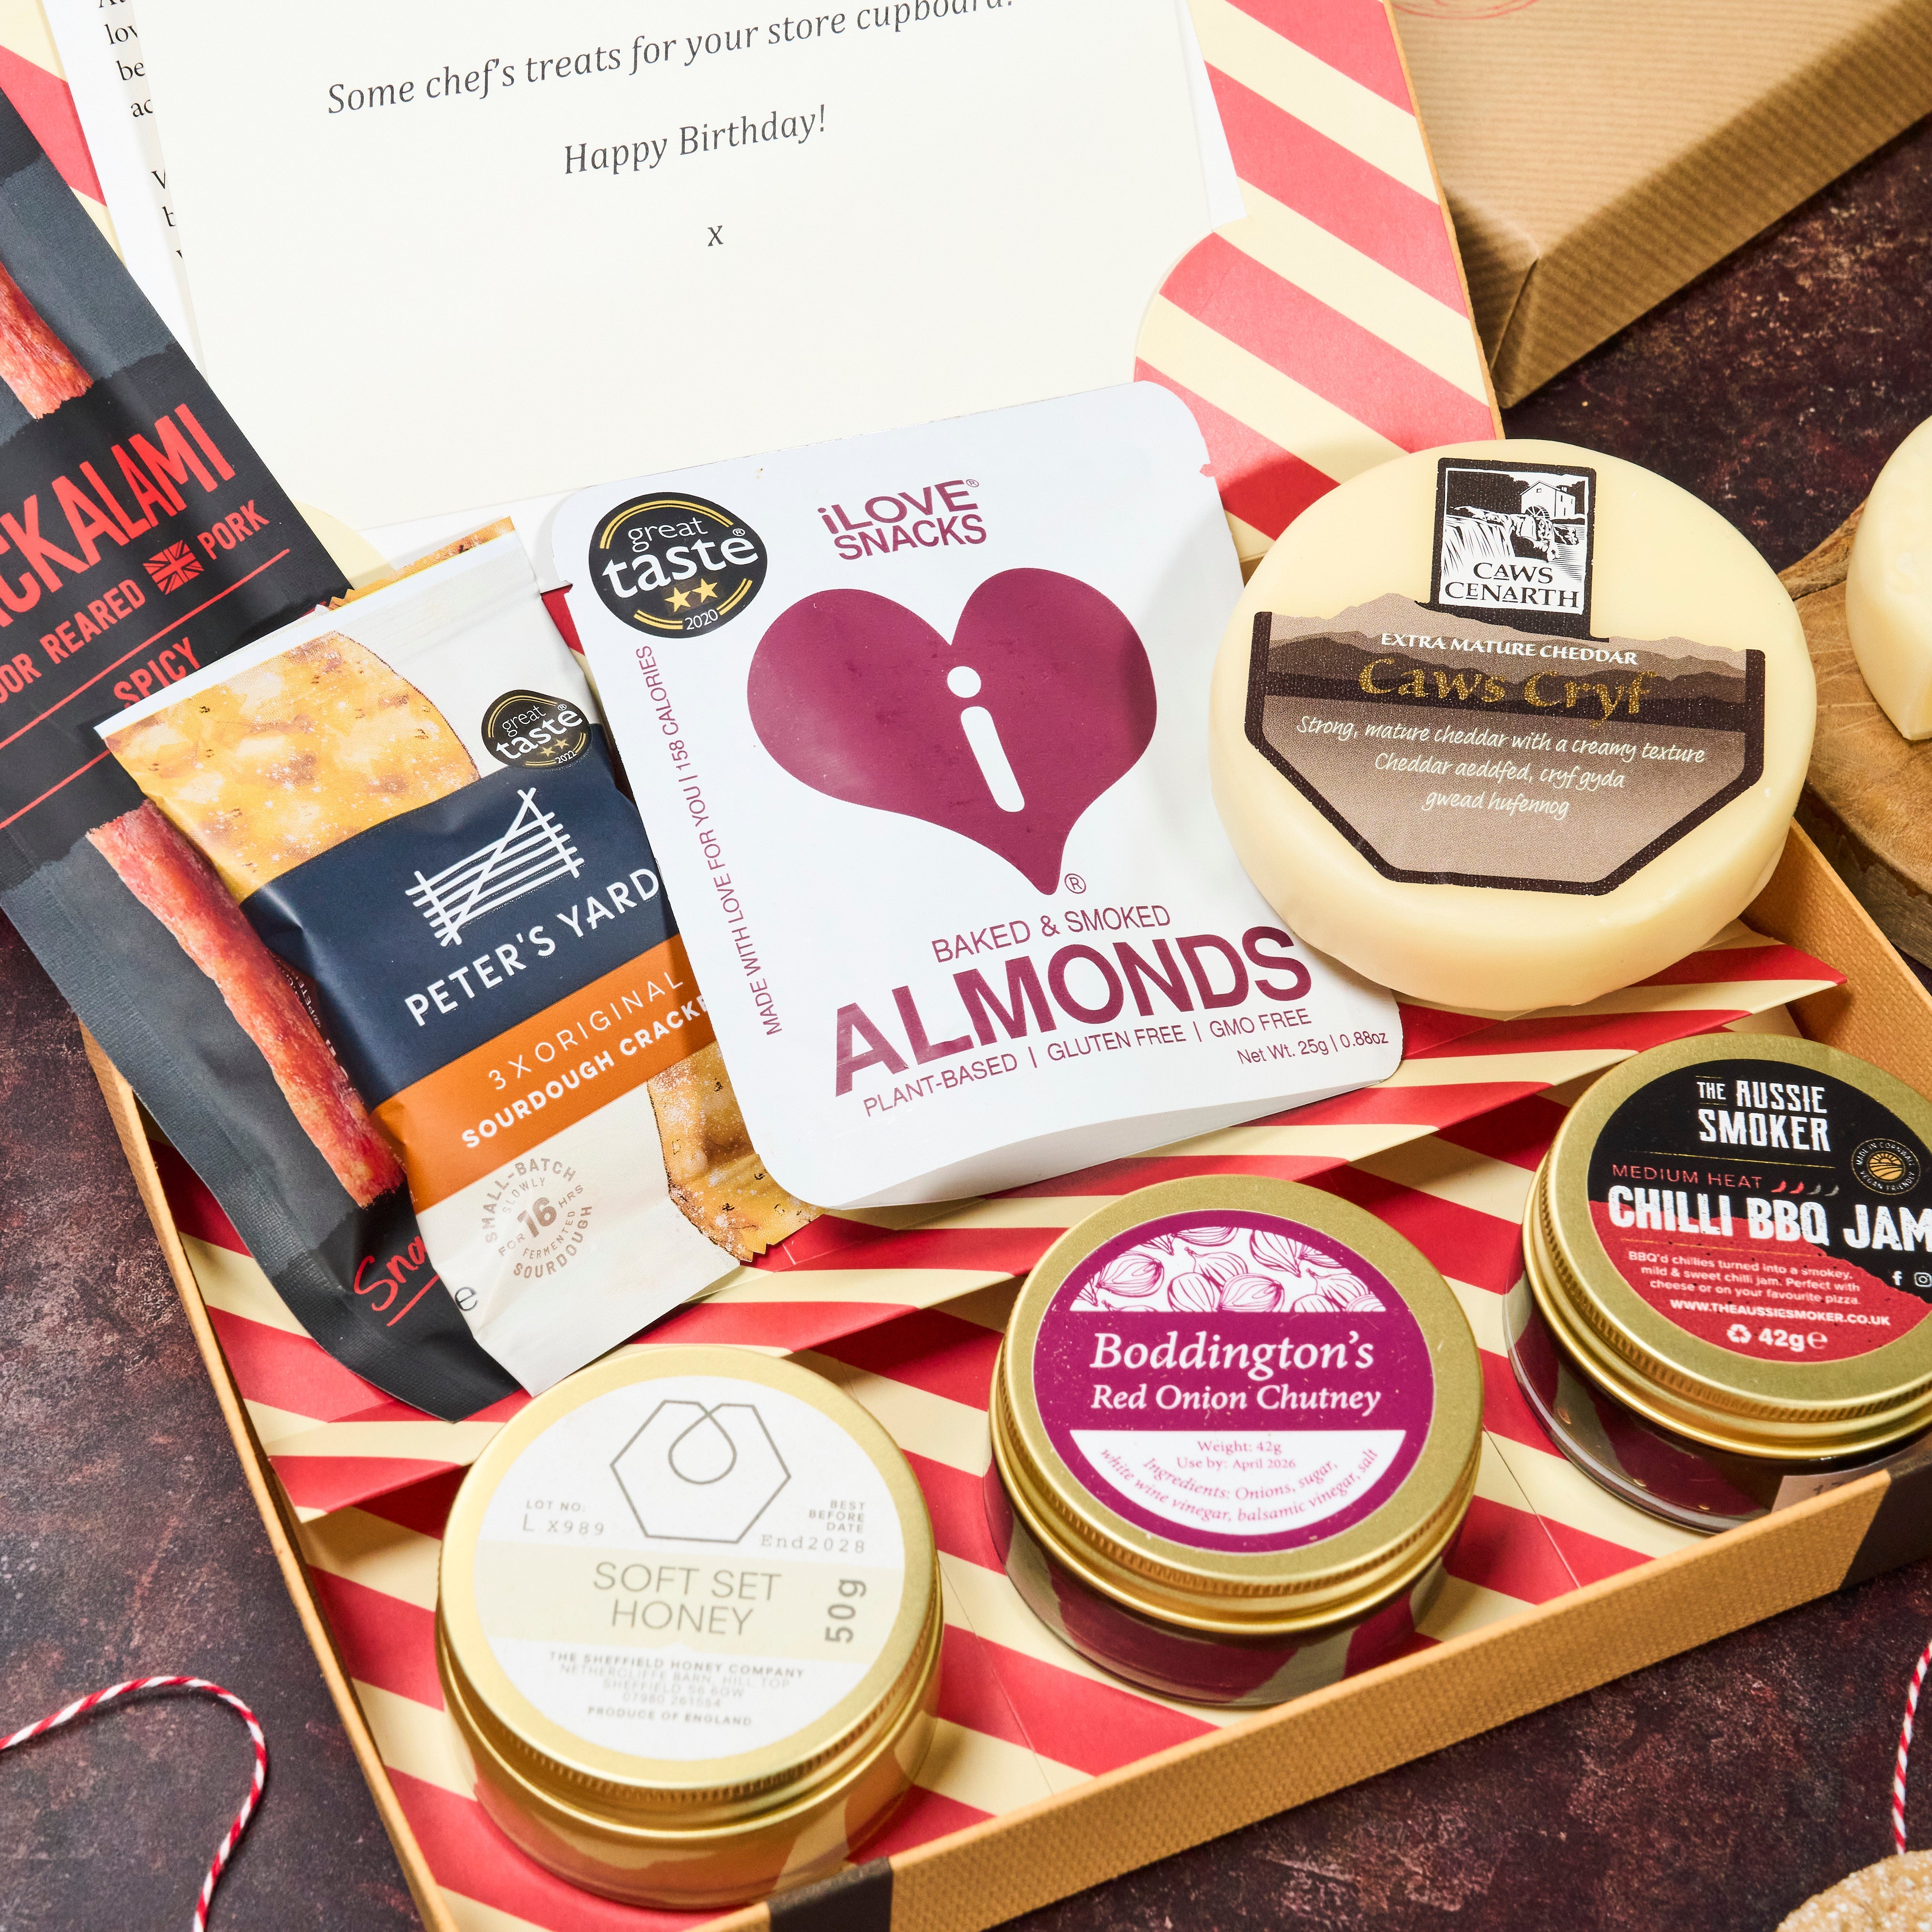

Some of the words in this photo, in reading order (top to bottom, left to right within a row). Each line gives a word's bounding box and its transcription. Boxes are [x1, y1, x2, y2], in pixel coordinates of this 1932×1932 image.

[328, 80, 414, 114] Some
[426, 58, 515, 99] chef's
[527, 46, 621, 83] treats
[629, 35, 677, 75] for
[684, 26, 759, 66] your
[768, 12, 846, 45] store
[565, 138, 668, 174] Happy
[679, 104, 825, 156] Birthday!
[707, 225, 724, 247] x
[0, 403, 235, 627] CKALAMI
[628, 517, 709, 553] great
[834, 514, 987, 560] SNACKS
[39, 579, 146, 665] REARED
[198, 499, 270, 559] PORK
[1473, 562, 1553, 583] CAWS
[1445, 582, 1579, 608] CENARTH
[685, 609, 718, 630] 2020
[1381, 633, 1446, 650] EXTRA
[1450, 638, 1536, 657] MATURE
[1540, 645, 1638, 666] CHEDDAR
[114, 636, 201, 709] SPICY
[636, 645, 679, 736] CALORIES
[1359, 658, 1505, 703] Caws
[1524, 670, 1658, 727] Cryf
[502, 705, 546, 738] great
[1296, 716, 1358, 741] Strong,
[1365, 723, 1430, 741] mature
[1434, 724, 1509, 747] cheddar
[1512, 732, 1551, 752] with
[1555, 739, 1567, 753] a
[1572, 739, 1637, 762] creamy
[1641, 742, 1705, 764] texture
[555, 750, 577, 764] 2022
[668, 740, 691, 771] 158
[1375, 753, 1453, 774] Cheddar
[1455, 760, 1533, 784] aeddfed,
[1540, 765, 1581, 790] cryf
[1575, 769, 1625, 791] gyda
[683, 786, 709, 827] YOU
[1421, 791, 1486, 811] gwead
[1488, 791, 1570, 821] hufennog
[699, 829, 725, 870] FOR
[713, 873, 744, 923] LOVE
[404, 925, 555, 1026] PETER'S
[556, 868, 659, 938] YARD
[732, 926, 761, 976] WITH
[931, 920, 1031, 963] BAKED
[1040, 915, 1061, 937] &
[1064, 905, 1171, 933] SMOKED
[535, 971, 683, 1063] ORIGINAL
[750, 978, 782, 1036] MADE
[836, 926, 1311, 1097] ALMONDS
[863, 1053, 1018, 1117] PLANT-BASED
[1047, 1030, 1132, 1061] GLUTEN
[1134, 1021, 1186, 1046] FREE
[1209, 1016, 1255, 1038] GMO
[1259, 1008, 1312, 1031] FREE
[1237, 1048, 1267, 1065] Net
[1267, 1042, 1296, 1060] Wt.
[1300, 1037, 1330, 1056] 25g
[1339, 1030, 1389, 1049] 0.88oz
[462, 1051, 614, 1148] SOURDOUGH
[1697, 1081, 1726, 1101] THE
[1735, 1080, 1828, 1114] AUSSIE
[1698, 1108, 1831, 1152] SMOKER
[502, 1177, 545, 1213] SLOWLY
[1612, 1164, 1699, 1184] MEDIUM
[1707, 1172, 1762, 1189] HEAT
[482, 1158, 576, 1243] SMALL-BATCH
[1607, 1185, 1733, 1236] CHILLI
[1746, 1196, 1830, 1246] BBQ
[1843, 1204, 1932, 1252] JAM
[498, 1233, 526, 1256] FOR
[517, 1197, 557, 1238] 16
[558, 1185, 583, 1208] HRS
[523, 1210, 575, 1259] FERMENTED
[513, 1206, 593, 1279] SOURDOUGH
[1628, 1251, 1668, 1263] BBQ'd
[1672, 1256, 1715, 1267] chillies
[1718, 1260, 1759, 1271] turned
[1763, 1263, 1787, 1274] into
[1641, 1266, 1667, 1276] mild
[1671, 1268, 1680, 1278] &
[1683, 1270, 1721, 1280] sweet
[1724, 1273, 1753, 1283] chilli
[1756, 1277, 1782, 1286] jam.
[1786, 1278, 1832, 1291] Perfect
[1834, 1282, 1860, 1292] with
[1650, 1279, 1695, 1291] cheese
[1715, 1286, 1732, 1294] on
[1734, 1288, 1763, 1297] your
[1766, 1289, 1820, 1302] favourite
[1825, 1294, 1861, 1305] pizza.
[1670, 1299, 1891, 1326] WWW.THEAUSSIESMOKER.CO.UK
[1089, 1331, 1374, 1381] Boddington's
[1091, 1384, 1147, 1409] Red
[1155, 1384, 1247, 1410] Onion
[1256, 1383, 1381, 1417] Chutney
[1177, 1457, 1202, 1468] Use
[1207, 1457, 1227, 1472] by:
[1233, 1459, 1263, 1471] April
[1267, 1459, 1296, 1469] 2026
[1197, 1440, 1252, 1455] Weight:
[1256, 1441, 1281, 1455] 42g
[1101, 1449, 1134, 1480] white
[1135, 1479, 1169, 1503] wine
[1172, 1499, 1232, 1522] vinegar,
[1238, 1502, 1306, 1521] balsamic
[1308, 1473, 1361, 1507] vinegar,
[1359, 1449, 1378, 1473] salt
[1143, 1458, 1230, 1498] Ingredients:
[1235, 1484, 1296, 1500] Onions,
[1298, 1461, 1337, 1487] sugar,
[526, 1499, 553, 1510] LOT
[809, 1509, 865, 1522] BEFORE
[830, 1499, 865, 1510] BEST
[826, 1522, 864, 1533] DATE
[593, 1562, 700, 1595] SOFT
[711, 1569, 782, 1601] SET
[612, 1599, 754, 1635] HONEY
[824, 1578, 867, 1644] 50g
[551, 1651, 576, 1662] THE
[584, 1653, 664, 1668] SHEFFIELD
[671, 1660, 723, 1672] HONEY
[729, 1664, 804, 1677] COMPANY
[603, 1678, 682, 1693] SHEFFIELD
[762, 1678, 790, 1689] TOP
[588, 1705, 655, 1720] PRODUCE
[661, 1711, 679, 1721] OF
[685, 1712, 753, 1726] ENGLAND
